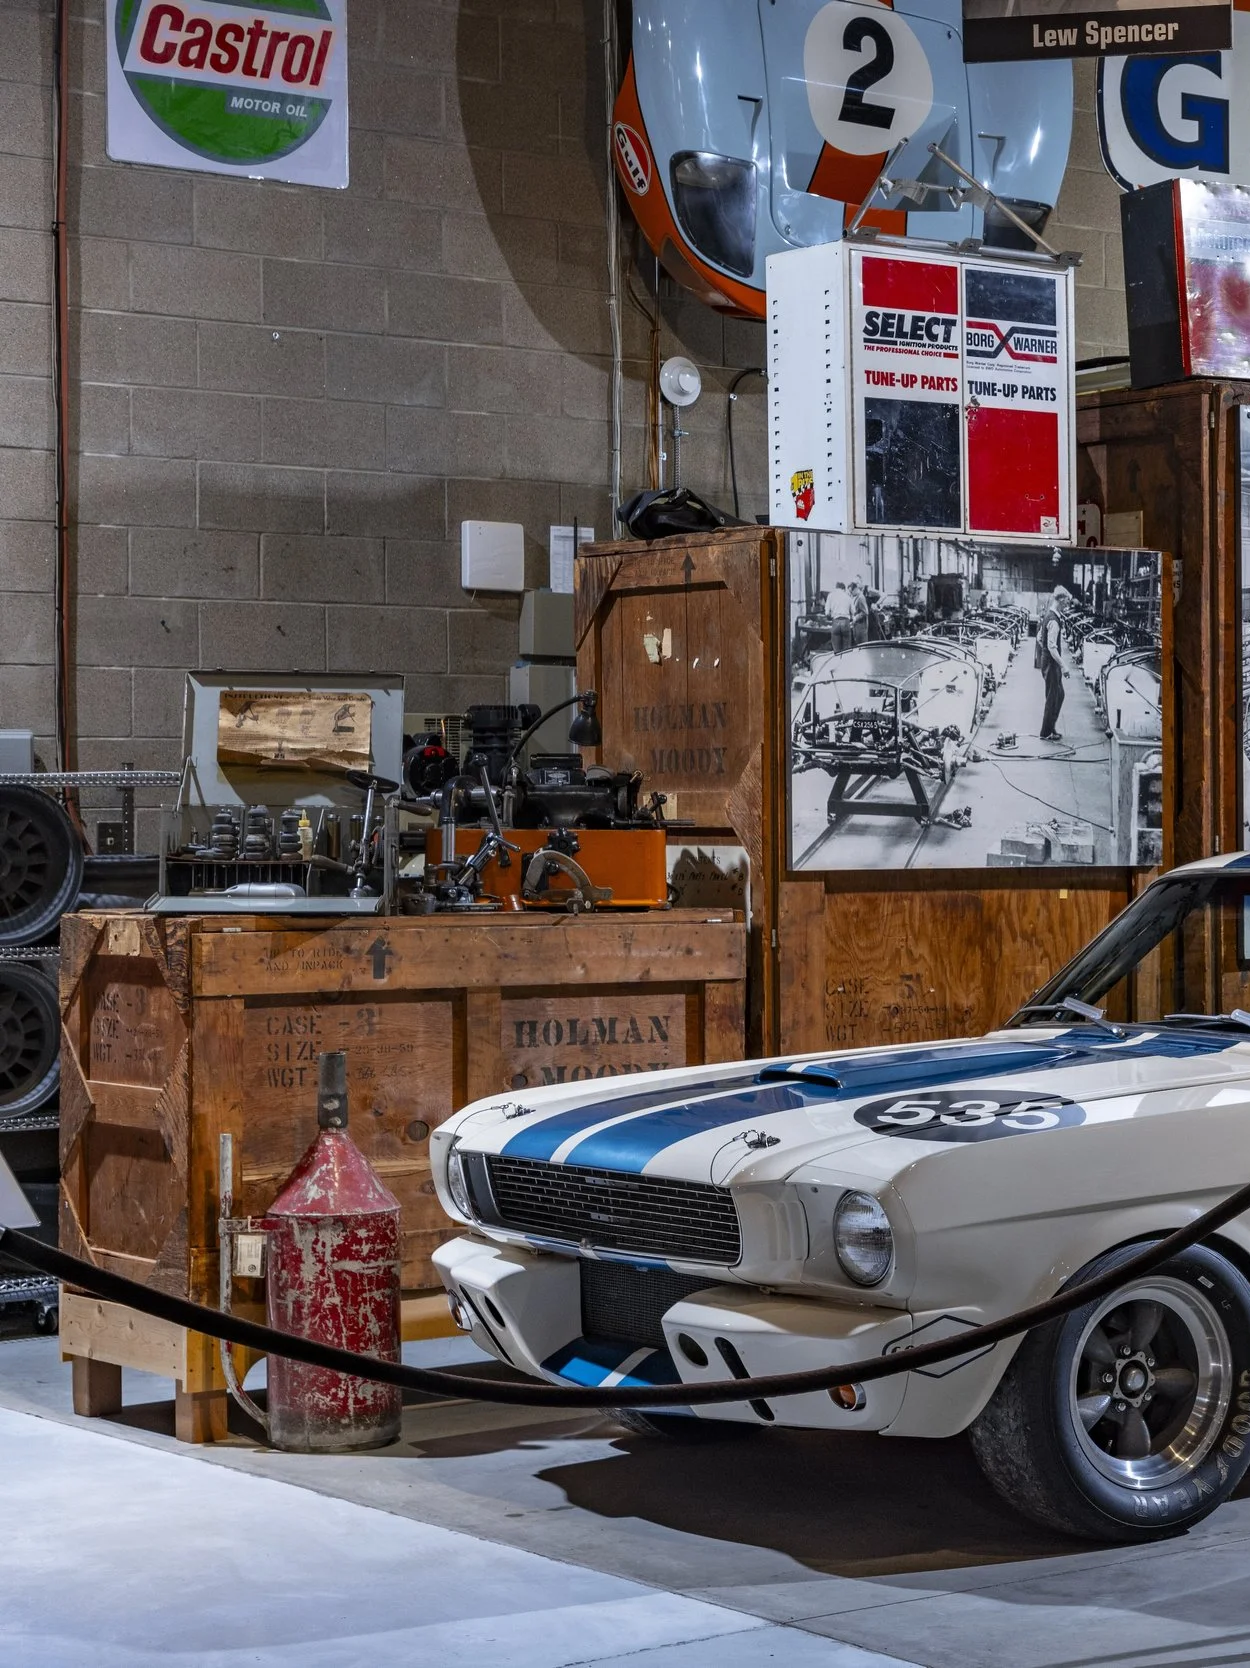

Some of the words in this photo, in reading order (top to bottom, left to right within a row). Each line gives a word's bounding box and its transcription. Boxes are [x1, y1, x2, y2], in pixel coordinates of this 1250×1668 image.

[139, 3, 333, 87] Castrol
[1032, 22, 1078, 48] Lew
[1085, 20, 1179, 50] Spencer
[838, 16, 896, 130] 2
[230, 96, 281, 114] MOTOR
[286, 104, 308, 118] OIL
[616, 127, 646, 189] Gulf
[863, 310, 958, 344] SELECT
[875, 345, 920, 356] PROFESSIONAL
[899, 340, 926, 348] IGNITION
[927, 343, 959, 352] PRODUCTS
[966, 331, 995, 349] BORG
[1013, 336, 1057, 354] WARNER
[864, 369, 918, 389] TUNE-UP
[921, 375, 958, 392] PARTS
[967, 380, 1018, 398] TUNE-UP
[1021, 385, 1057, 401] PARTS
[633, 701, 727, 732] HOLMAN
[650, 747, 727, 775] MOODY
[291, 948, 305, 957] TO
[313, 948, 343, 957] RIDE
[265, 960, 288, 970] AND
[266, 1015, 322, 1036] CASE
[513, 1015, 671, 1049] HOLMAN
[266, 1041, 322, 1062] SIZE
[877, 1100, 1063, 1130] 535
